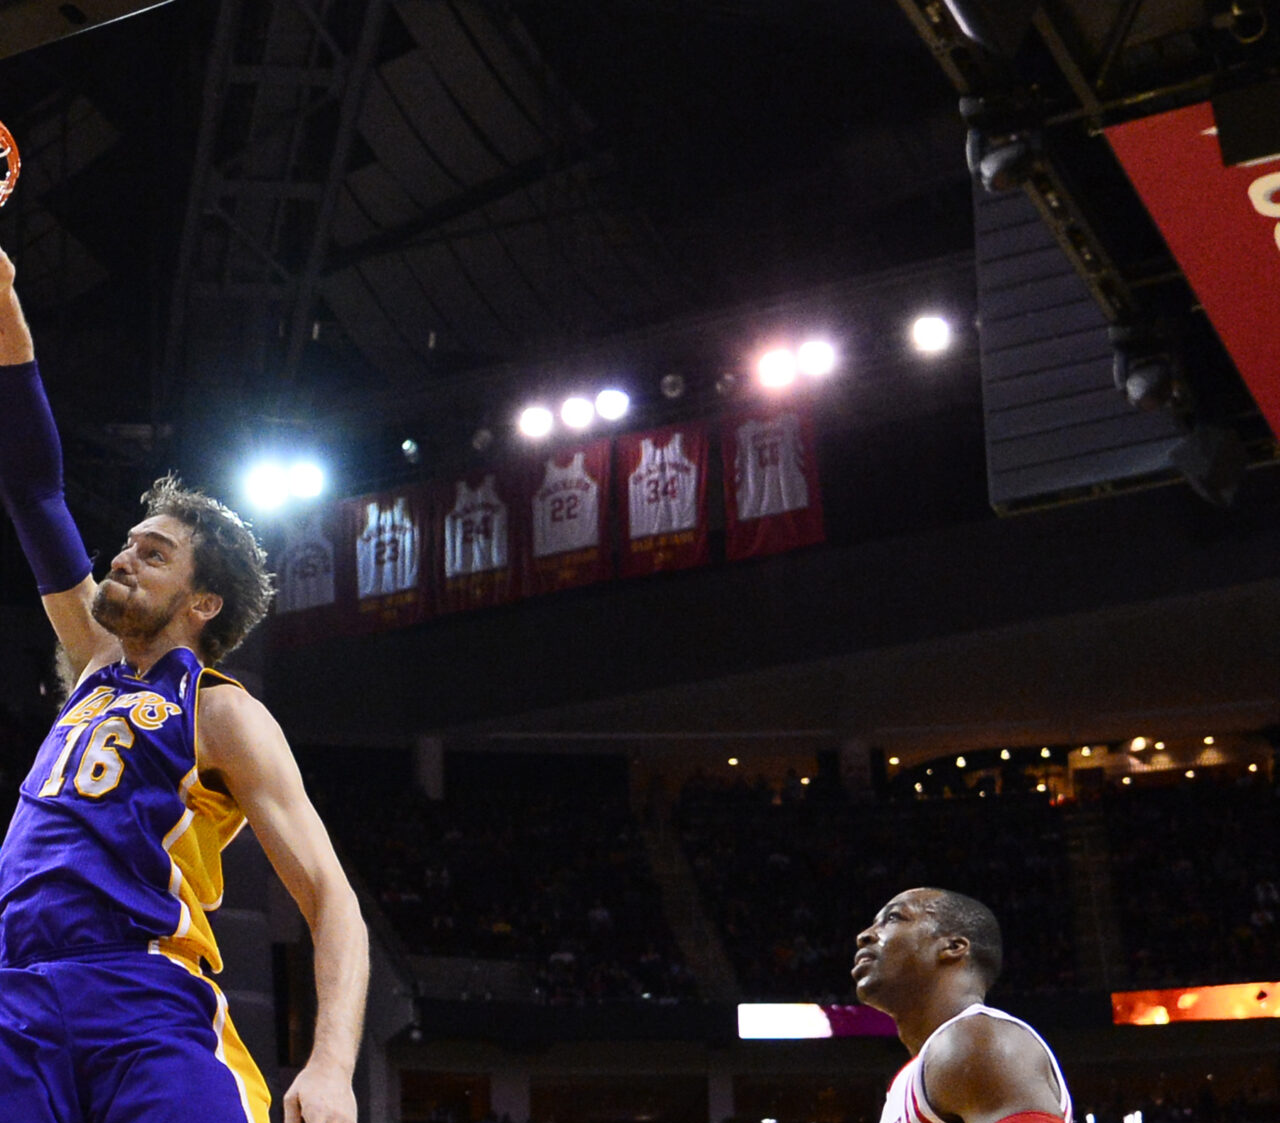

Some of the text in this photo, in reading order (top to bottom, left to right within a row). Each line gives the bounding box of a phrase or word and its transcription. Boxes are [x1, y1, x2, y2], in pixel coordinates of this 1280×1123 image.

[647, 478, 678, 504] 34
[550, 494, 579, 522] 22
[38, 716, 135, 798] 16
